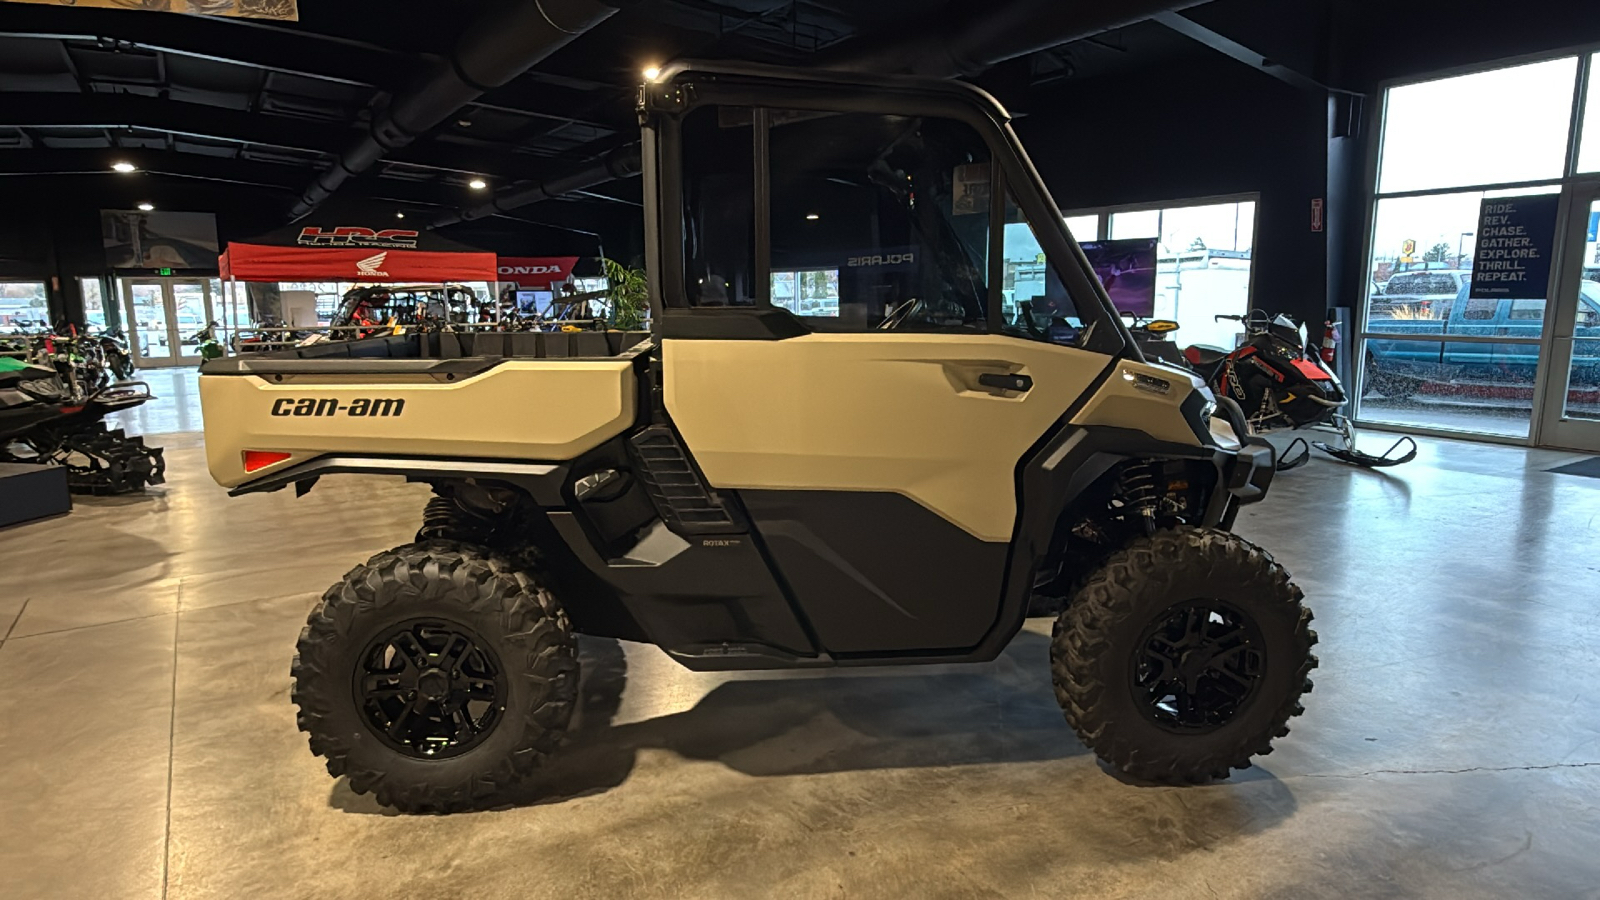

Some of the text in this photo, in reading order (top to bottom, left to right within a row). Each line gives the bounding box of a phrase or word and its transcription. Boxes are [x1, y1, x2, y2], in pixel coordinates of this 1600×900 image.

[1485, 204, 1516, 214] RIDE.
[1484, 216, 1511, 225] REV.
[297, 226, 419, 245] HRC
[1482, 226, 1527, 236] CHASE.
[1481, 237, 1533, 248] GATHER.
[1480, 249, 1540, 259] EXPLORE.
[497, 265, 562, 275] ONDA
[1479, 260, 1526, 271] THRILL.
[1476, 271, 1527, 281] REPEAT.
[271, 398, 405, 417] can-am
